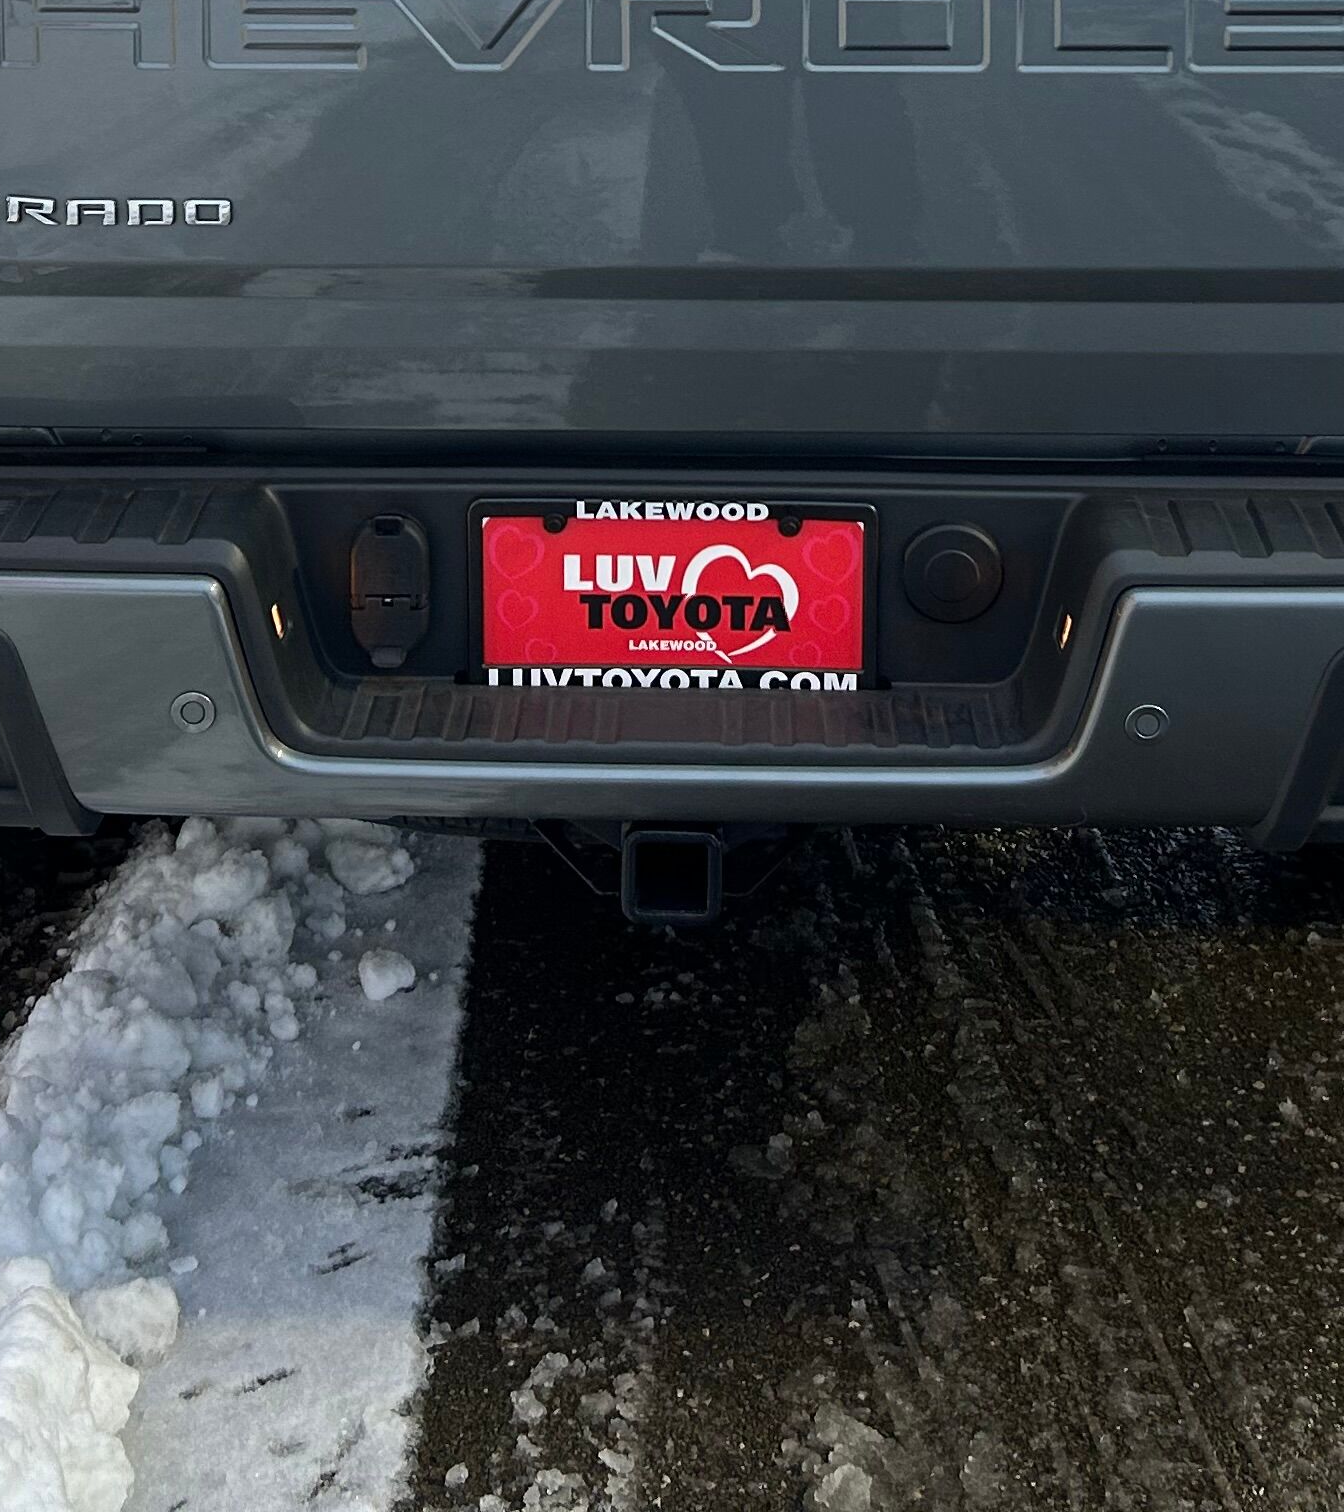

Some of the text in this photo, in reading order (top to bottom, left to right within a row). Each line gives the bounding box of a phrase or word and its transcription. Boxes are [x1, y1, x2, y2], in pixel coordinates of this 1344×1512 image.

[576, 501, 769, 522] LAKEWOOD
[563, 555, 677, 592] LUV
[580, 594, 791, 632] TOYOTA
[628, 639, 717, 652] LAKEWOOD
[488, 667, 857, 691] LUVTOYOTACOM
